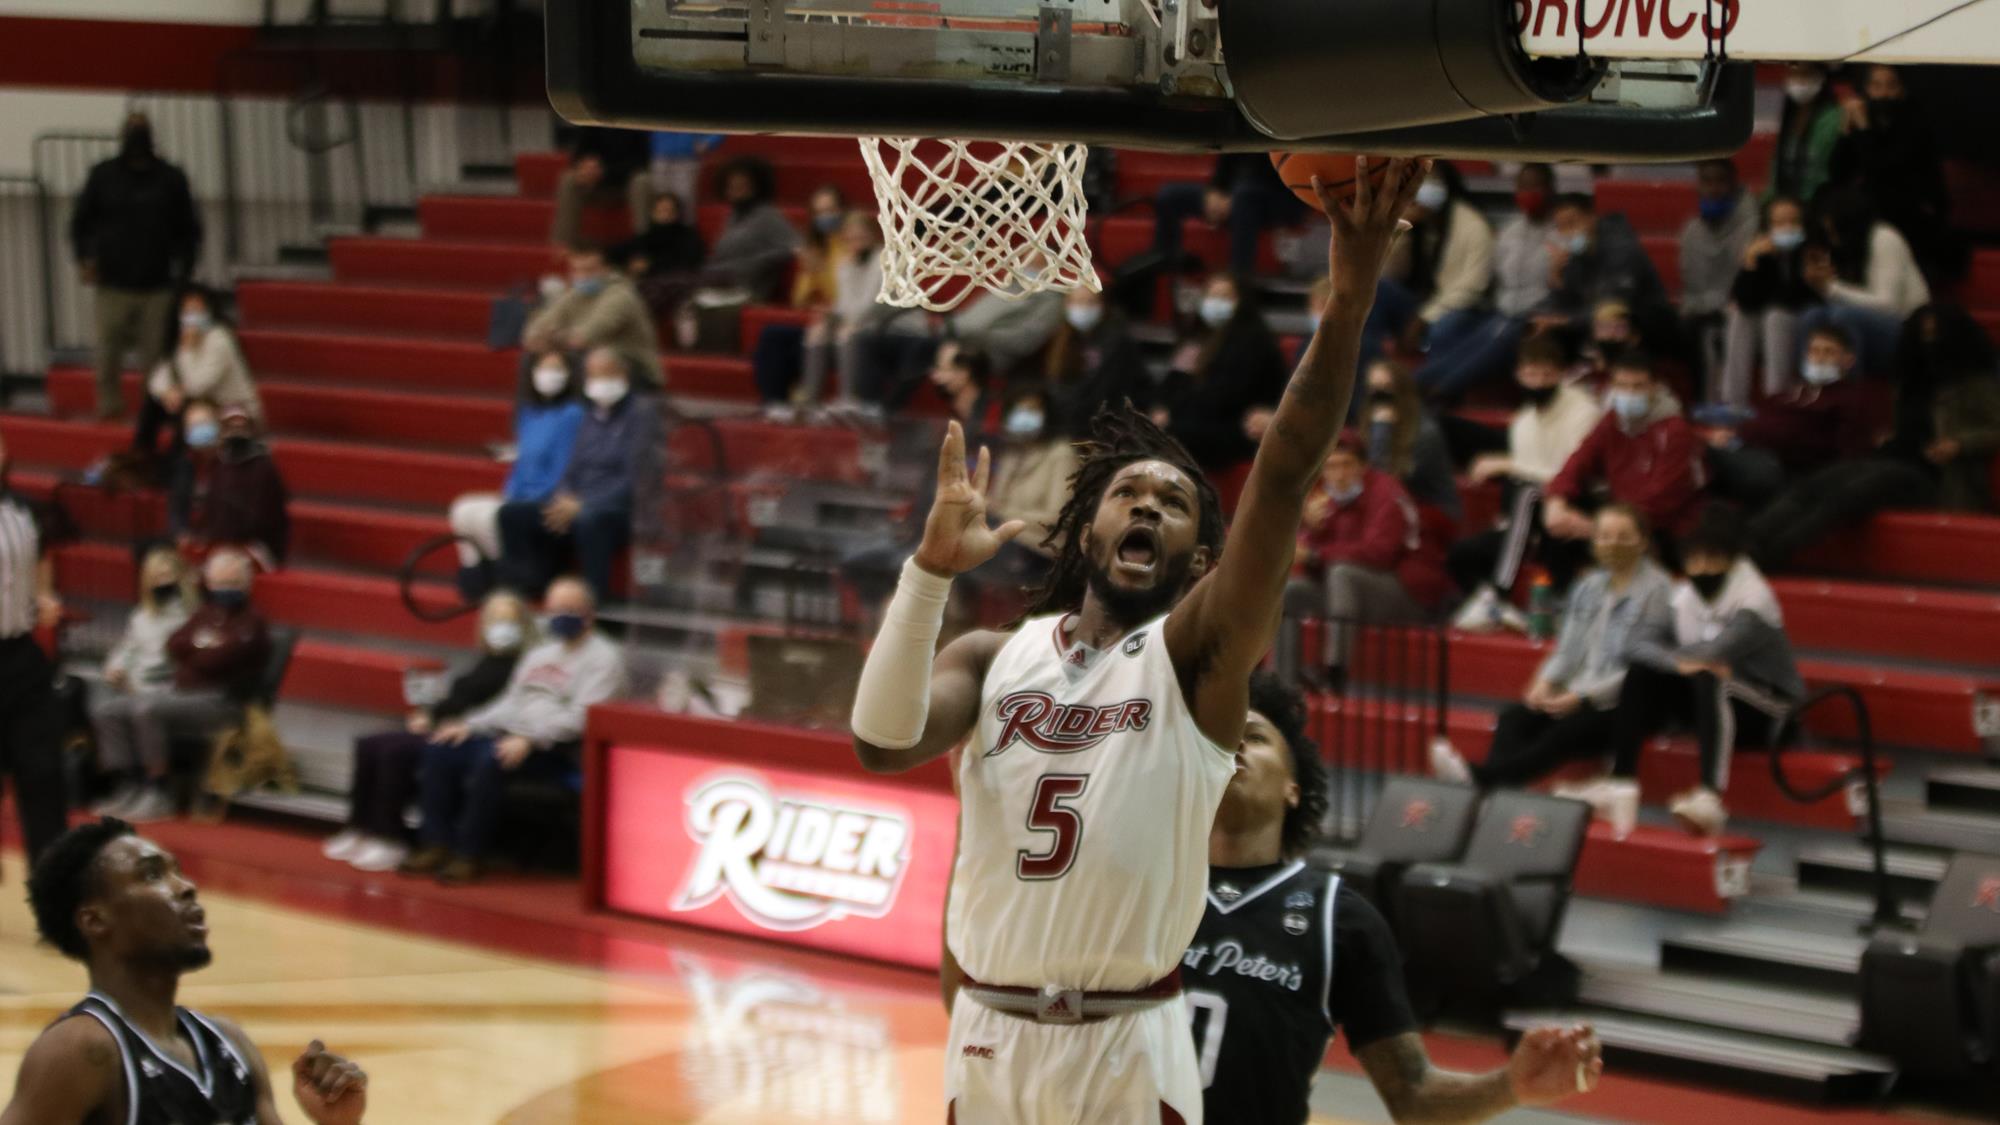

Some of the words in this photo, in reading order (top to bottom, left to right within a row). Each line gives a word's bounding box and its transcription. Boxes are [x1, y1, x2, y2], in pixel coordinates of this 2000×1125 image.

[1519, 0, 1740, 40] RONCS
[984, 691, 1152, 758] RIDER
[672, 779, 908, 926] RIDER
[1016, 773, 1090, 881] 5
[1208, 941, 1303, 992] Peter's
